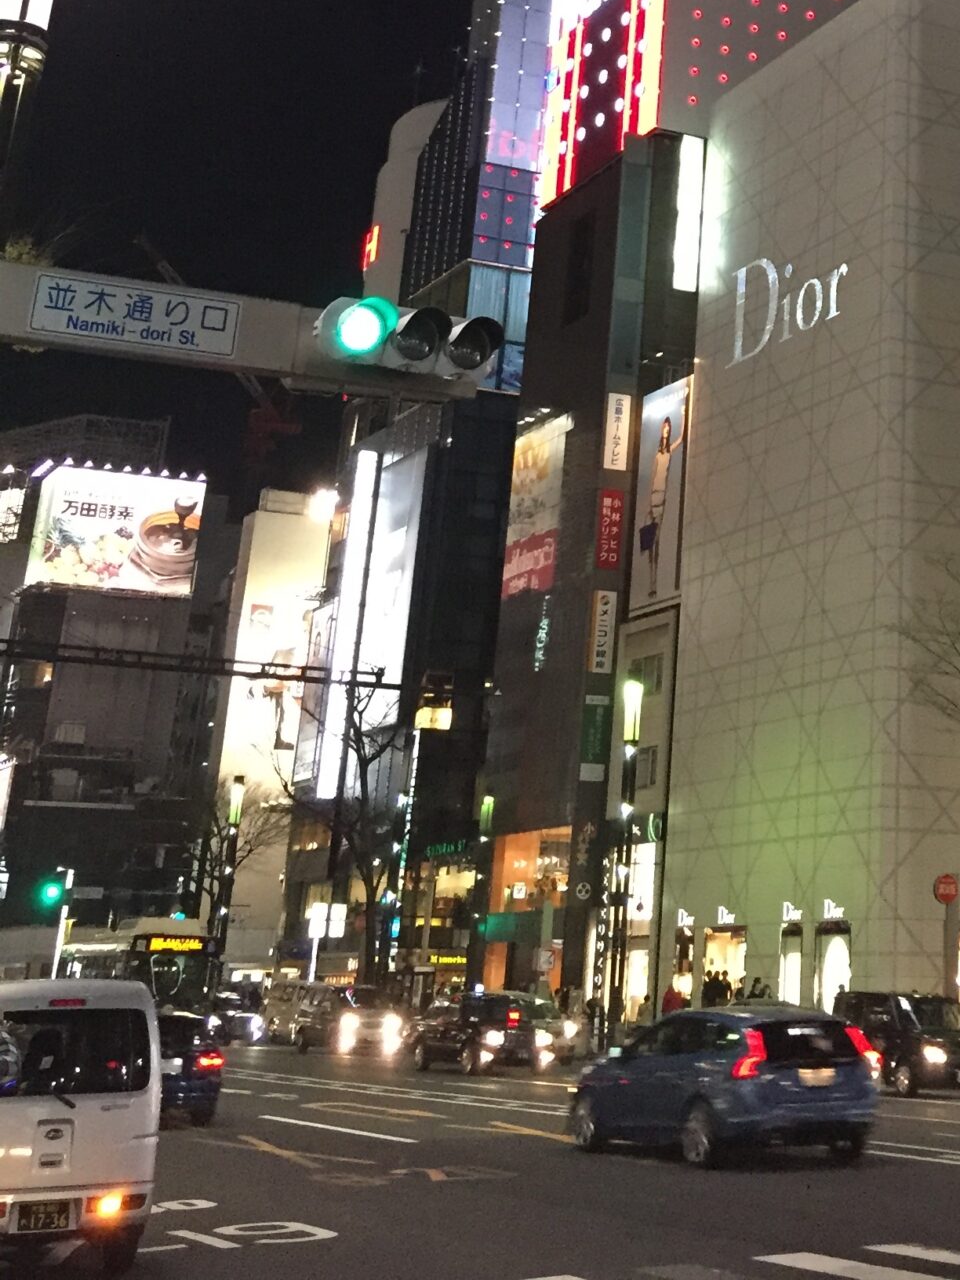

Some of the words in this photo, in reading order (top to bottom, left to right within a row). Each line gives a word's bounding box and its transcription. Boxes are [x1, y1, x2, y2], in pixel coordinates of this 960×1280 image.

[44, 282, 228, 332] 並木通り口
[725, 258, 848, 369] Dior
[178, 329, 200, 347] St.
[61, 499, 135, 522] 万田酵素
[677, 908, 695, 927] Dior
[718, 905, 736, 924] Dior
[783, 901, 803, 921] Dior
[824, 898, 845, 919] Dior
